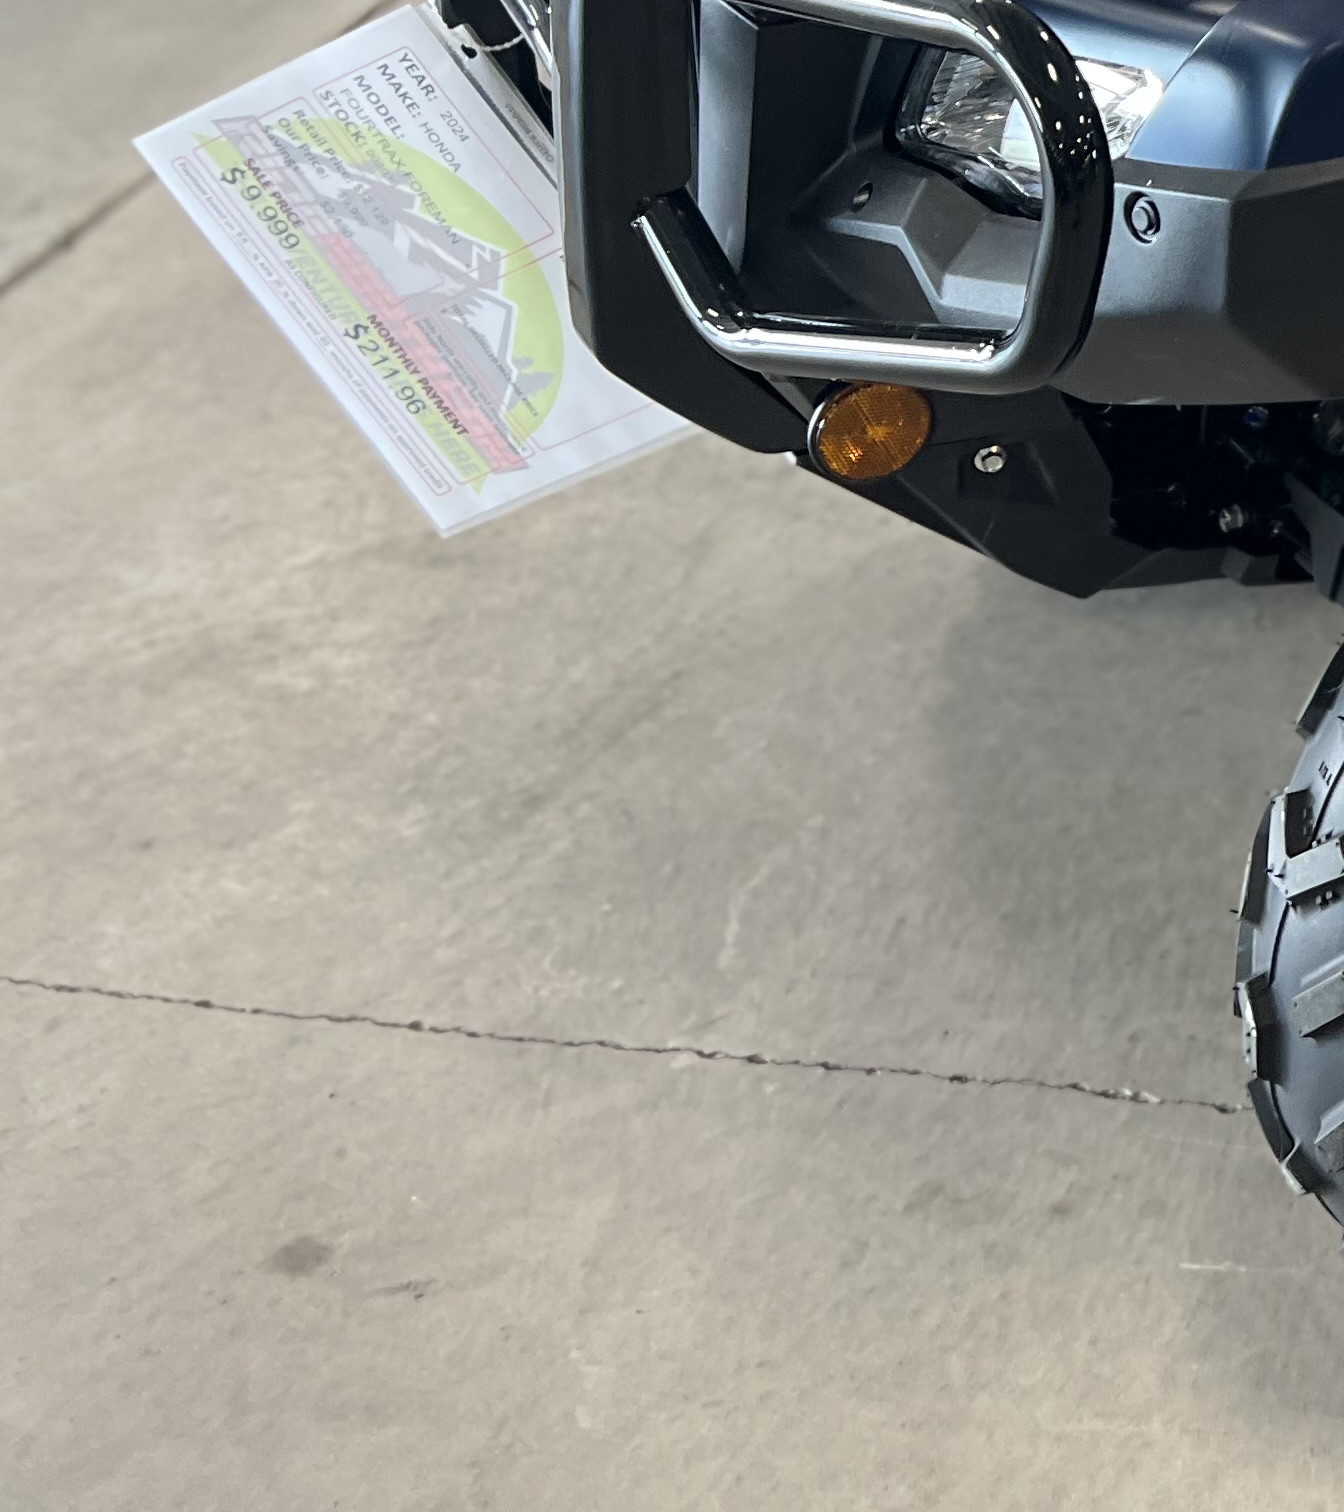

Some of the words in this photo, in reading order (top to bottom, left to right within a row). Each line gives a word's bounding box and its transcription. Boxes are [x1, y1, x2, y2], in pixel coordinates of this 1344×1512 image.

[316, 87, 372, 148] STOCK:
[349, 73, 410, 141] MODEL:
[373, 61, 426, 119] MAKE:
[416, 120, 465, 174] HONDA
[392, 51, 443, 104] YEAR:
[437, 108, 471, 144] 2024
[274, 114, 303, 143] Our
[295, 141, 333, 181] Price:
[290, 107, 329, 148] Retail
[320, 145, 358, 185] Price:
[335, 86, 409, 171] FOURTRAX
[397, 169, 465, 246] FOREMAN
[240, 155, 276, 192] SALE
[267, 188, 306, 230] PRICE
[364, 311, 423, 378] MONTHLY
[414, 375, 471, 439] PAYMENT
